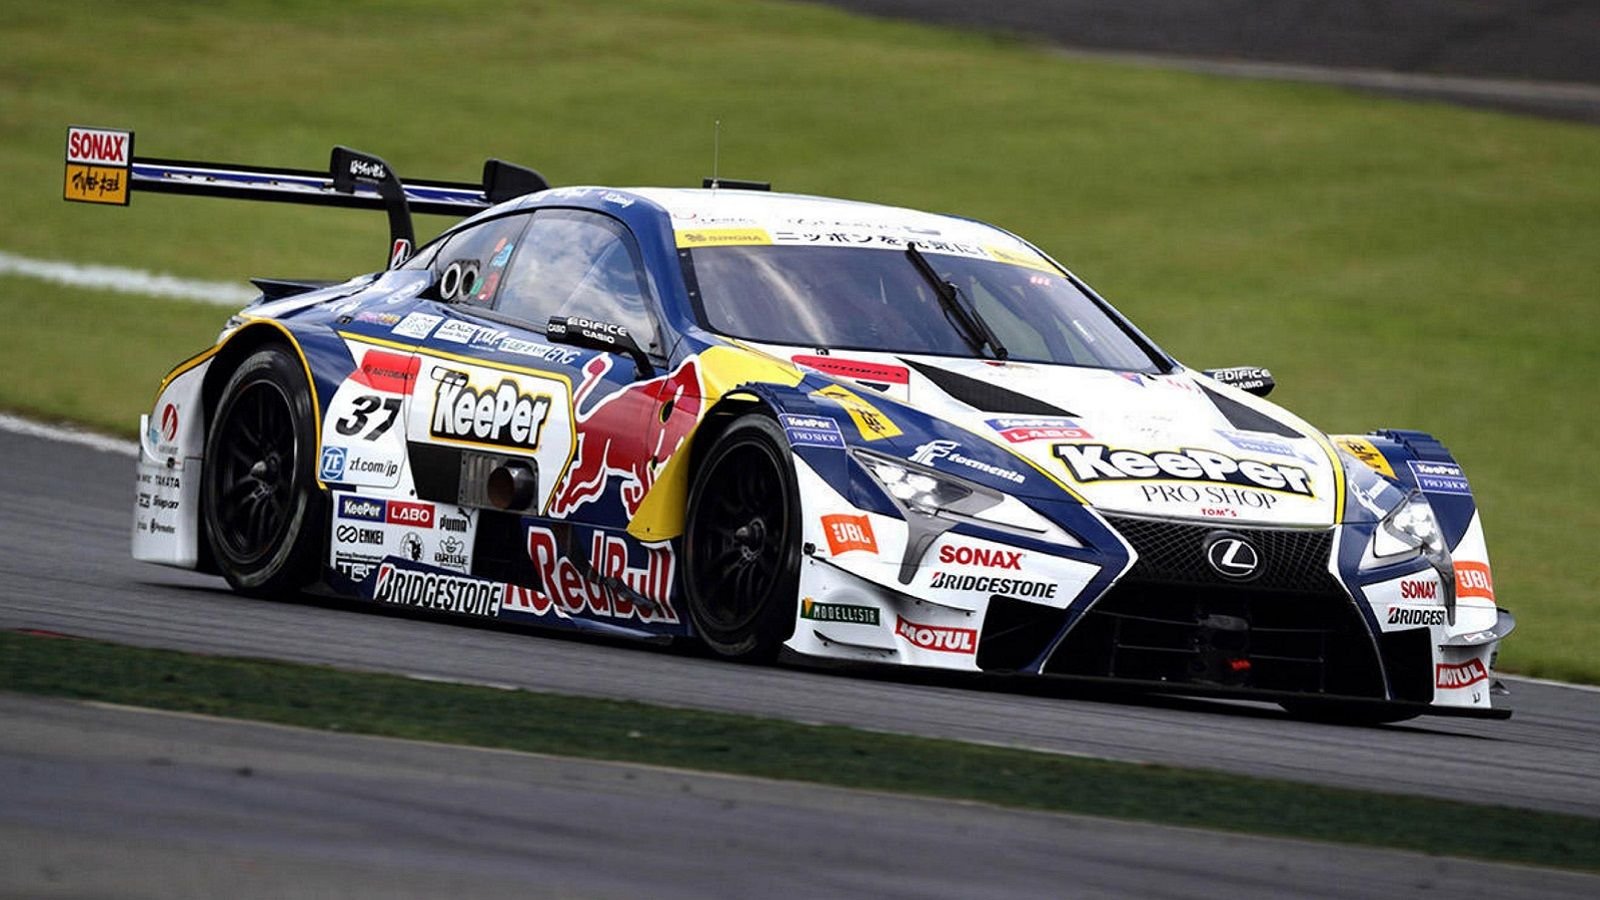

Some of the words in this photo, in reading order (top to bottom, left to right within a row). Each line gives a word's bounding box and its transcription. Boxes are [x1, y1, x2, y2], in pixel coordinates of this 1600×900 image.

[70, 132, 124, 161] SONAX
[567, 316, 627, 337] EDIFICE
[583, 329, 615, 344] CASIO
[1214, 369, 1271, 381] EDIFICE
[335, 395, 402, 441] 37
[431, 373, 552, 450] KeePer
[1012, 429, 1083, 440] LABO
[324, 452, 343, 473] ZF
[349, 457, 398, 477] zf.com/jp
[1054, 443, 1314, 496] KeePer
[155, 474, 180, 489] TAKATA
[1140, 484, 1200, 502] PRO
[1205, 487, 1277, 510] SHOP
[344, 500, 381, 517] KeePer
[391, 507, 430, 523] LABO
[1201, 508, 1237, 517] TOM'S
[359, 528, 384, 545] ENKEI
[831, 522, 871, 544] JBL
[435, 552, 469, 565] BRIDE
[939, 545, 1022, 570] SONAX
[375, 566, 501, 617] BRIDGESTONE
[930, 572, 1058, 599] BRIDGESTONE
[1401, 581, 1438, 599] SONAX
[813, 604, 876, 624] MODELLISTA
[900, 623, 973, 650] MOTUL
[1437, 663, 1484, 686] MOTUL
